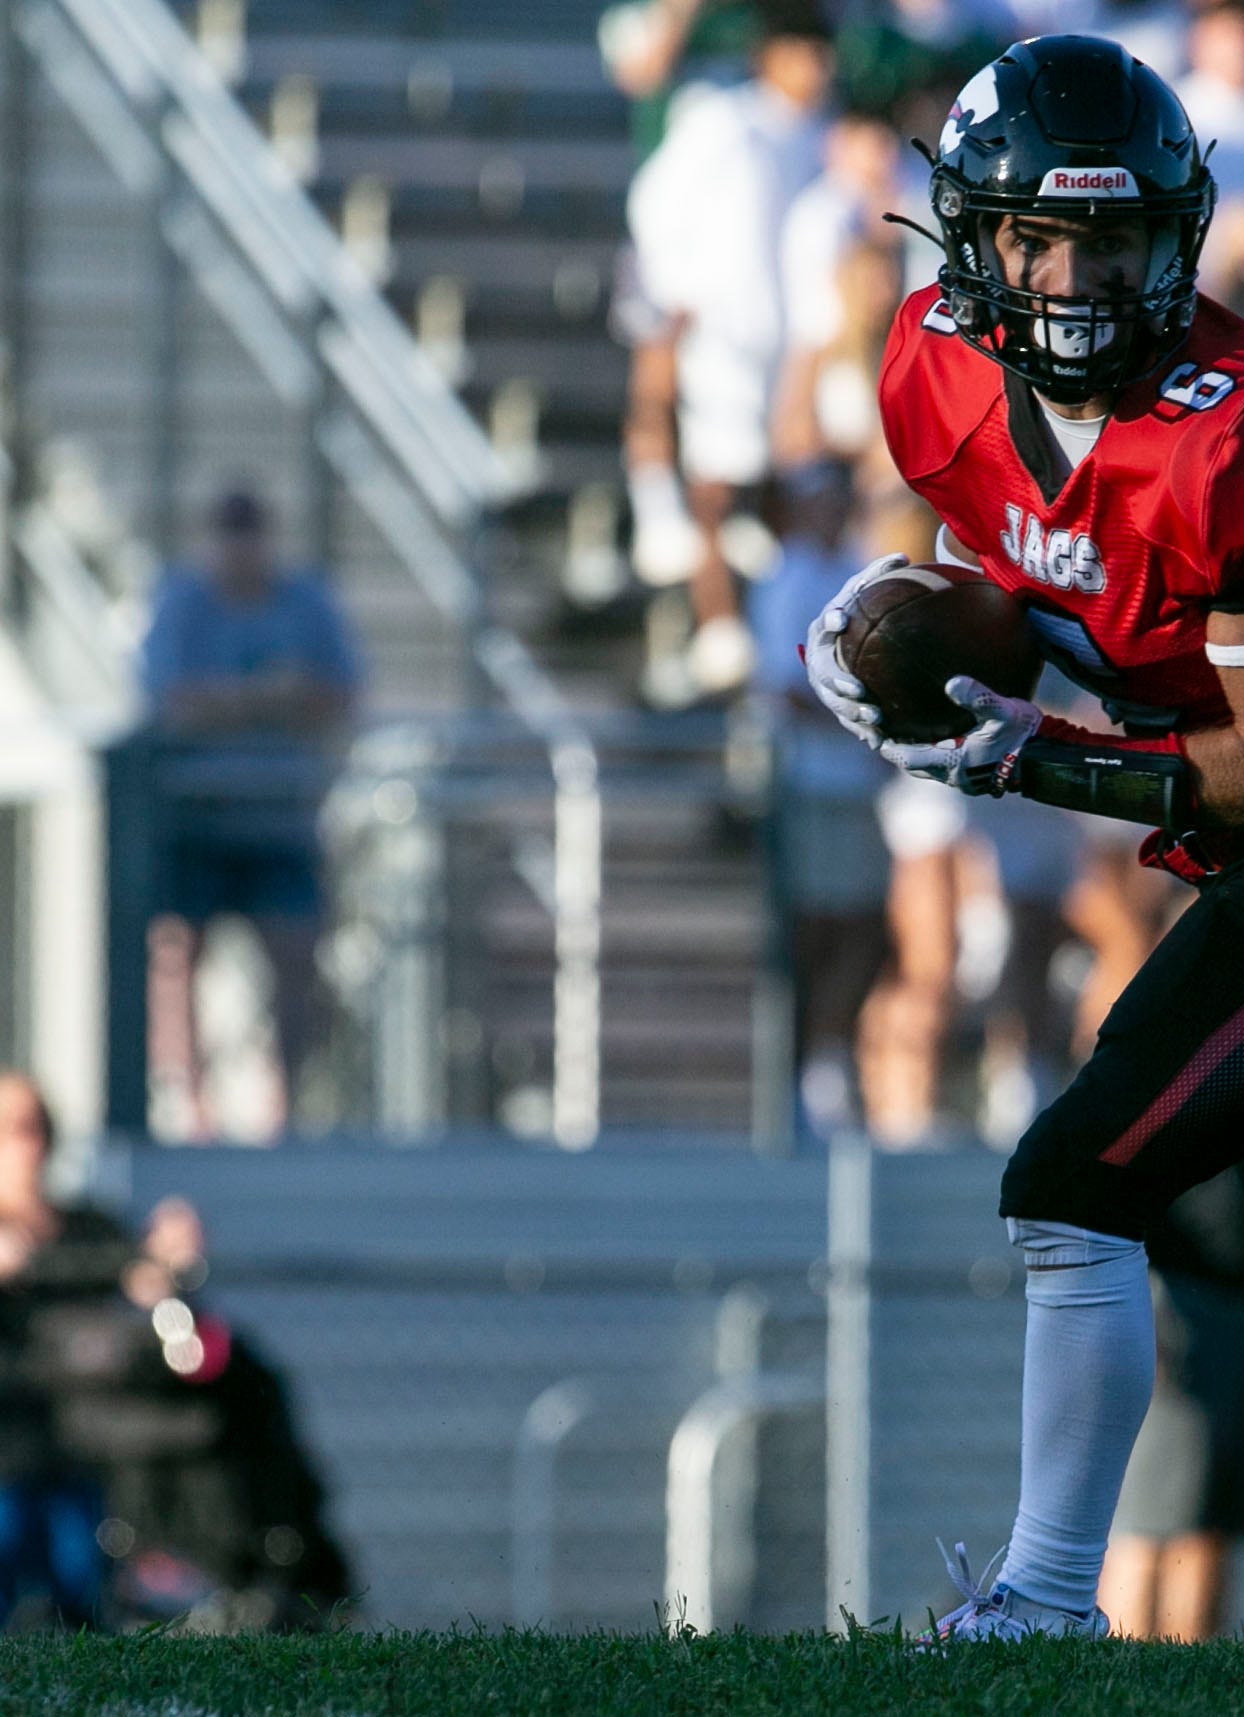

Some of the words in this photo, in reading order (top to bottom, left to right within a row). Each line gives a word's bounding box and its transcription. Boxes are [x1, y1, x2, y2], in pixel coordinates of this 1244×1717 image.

[1055, 173, 1127, 189] Riddell
[1158, 361, 1236, 411] 6
[1000, 502, 1107, 594] JAGS
